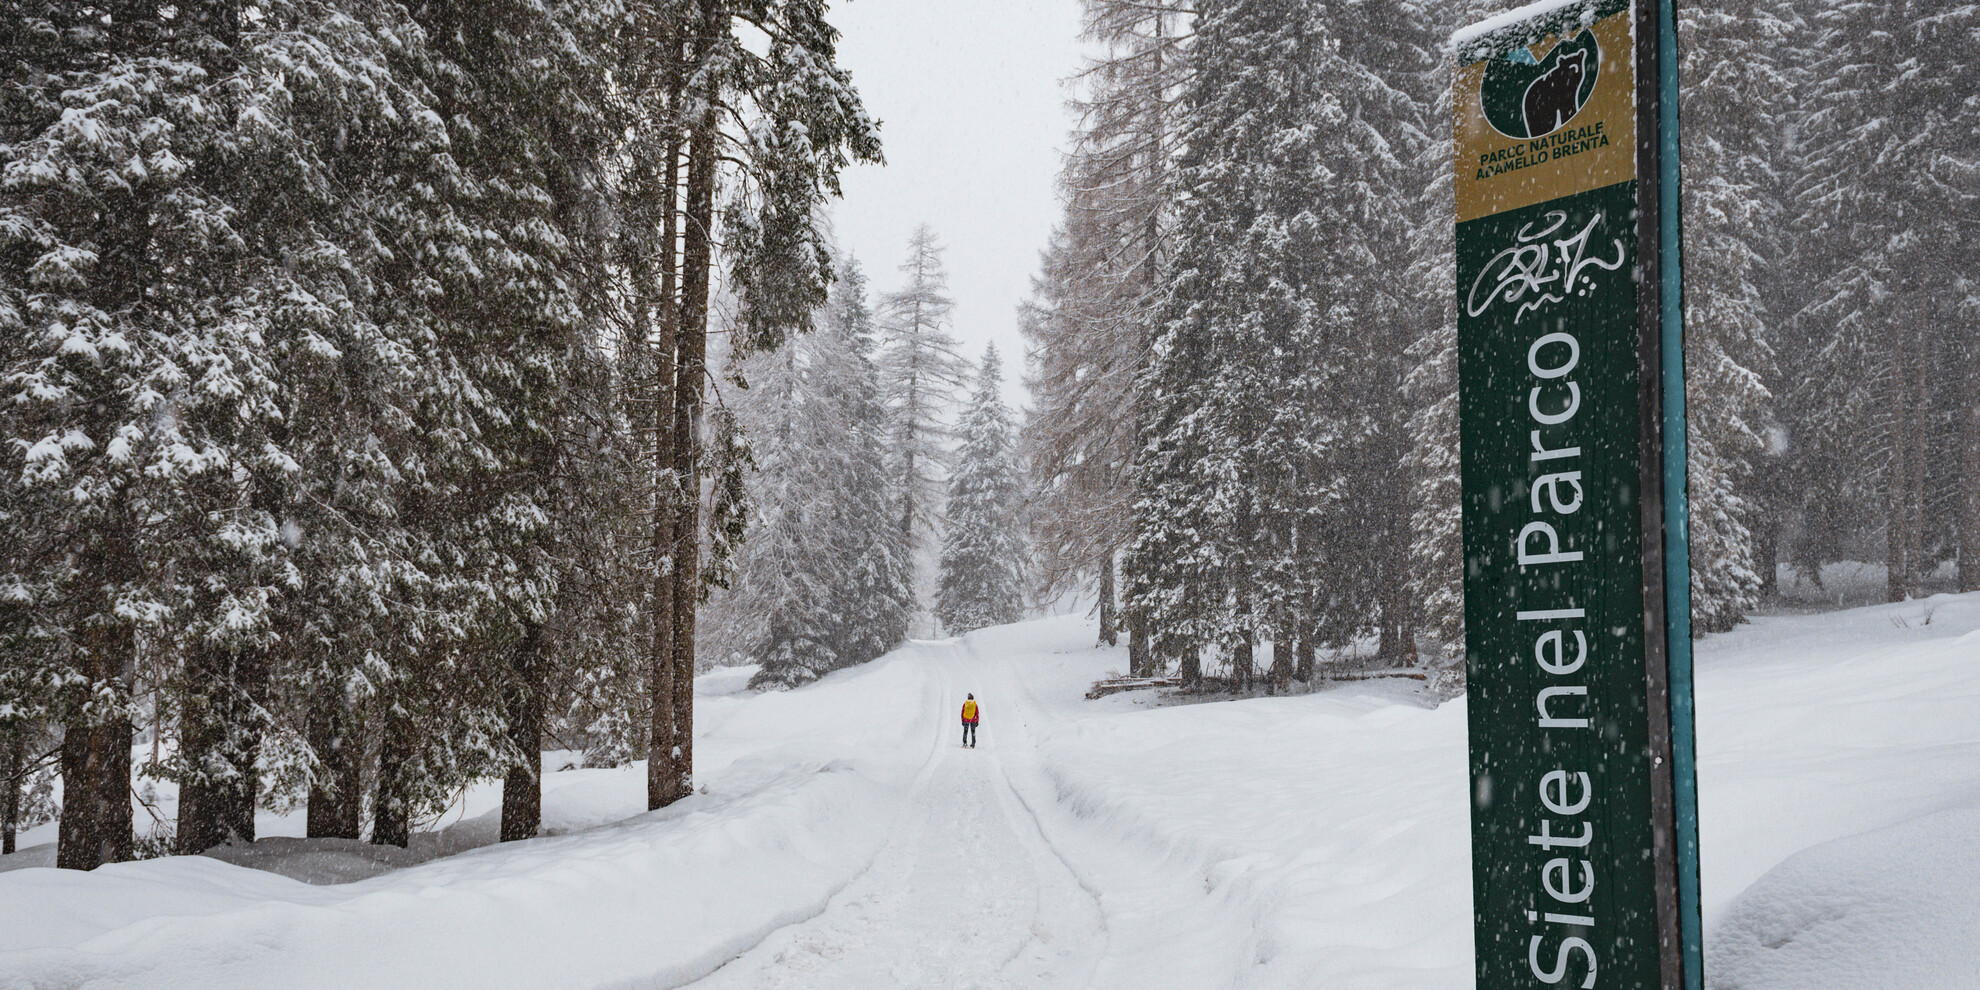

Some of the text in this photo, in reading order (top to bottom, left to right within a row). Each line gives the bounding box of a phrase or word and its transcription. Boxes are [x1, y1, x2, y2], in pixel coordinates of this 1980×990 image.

[1475, 134, 1609, 180] ADAMELLO BRENTA
[1480, 121, 1604, 166] PARCO NATURALE
[1517, 332, 1584, 565] Parco
[1516, 608, 1588, 728] nel
[1528, 769, 1597, 990] Siete
